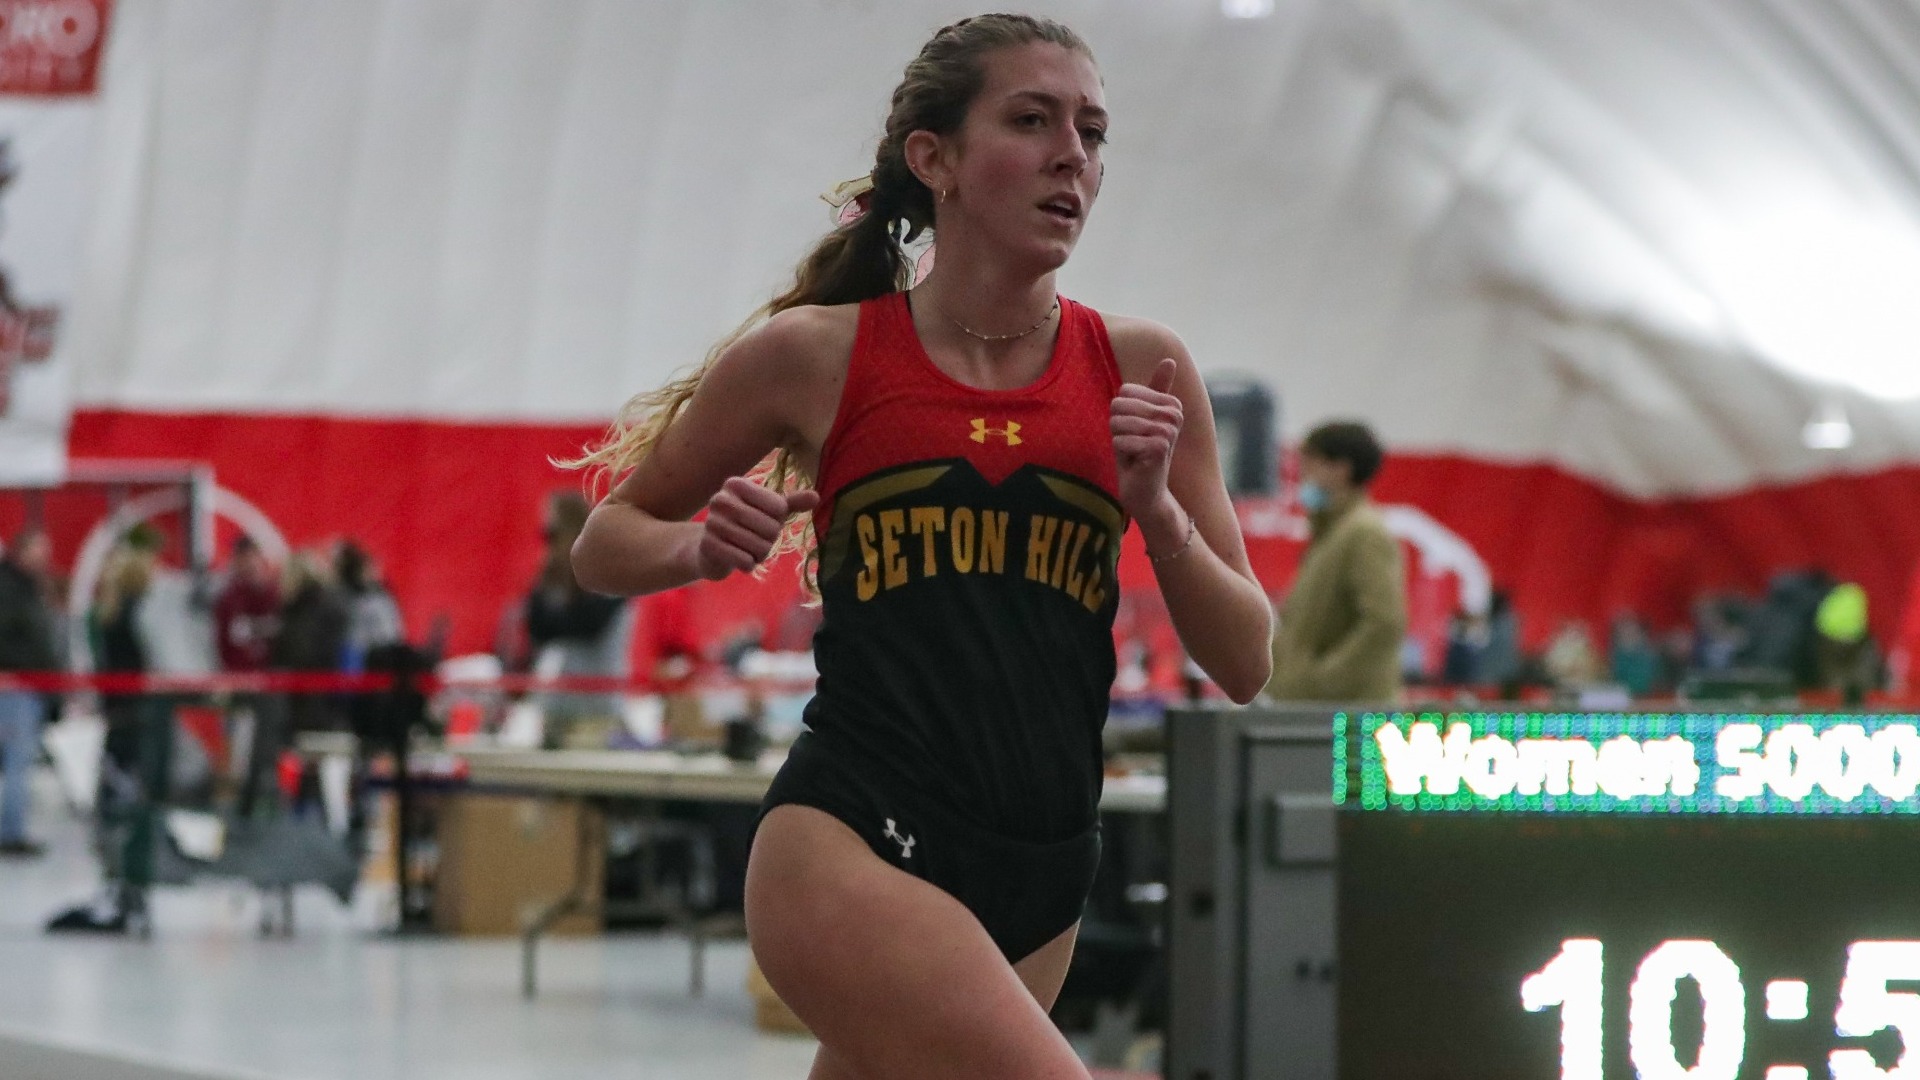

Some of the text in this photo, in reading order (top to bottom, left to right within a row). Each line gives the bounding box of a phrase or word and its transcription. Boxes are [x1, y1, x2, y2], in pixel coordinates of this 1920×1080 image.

[856, 506, 1105, 613] SETON HILL
[1376, 722, 1920, 801] Women 5000
[1521, 938, 1920, 1080] 10:5
